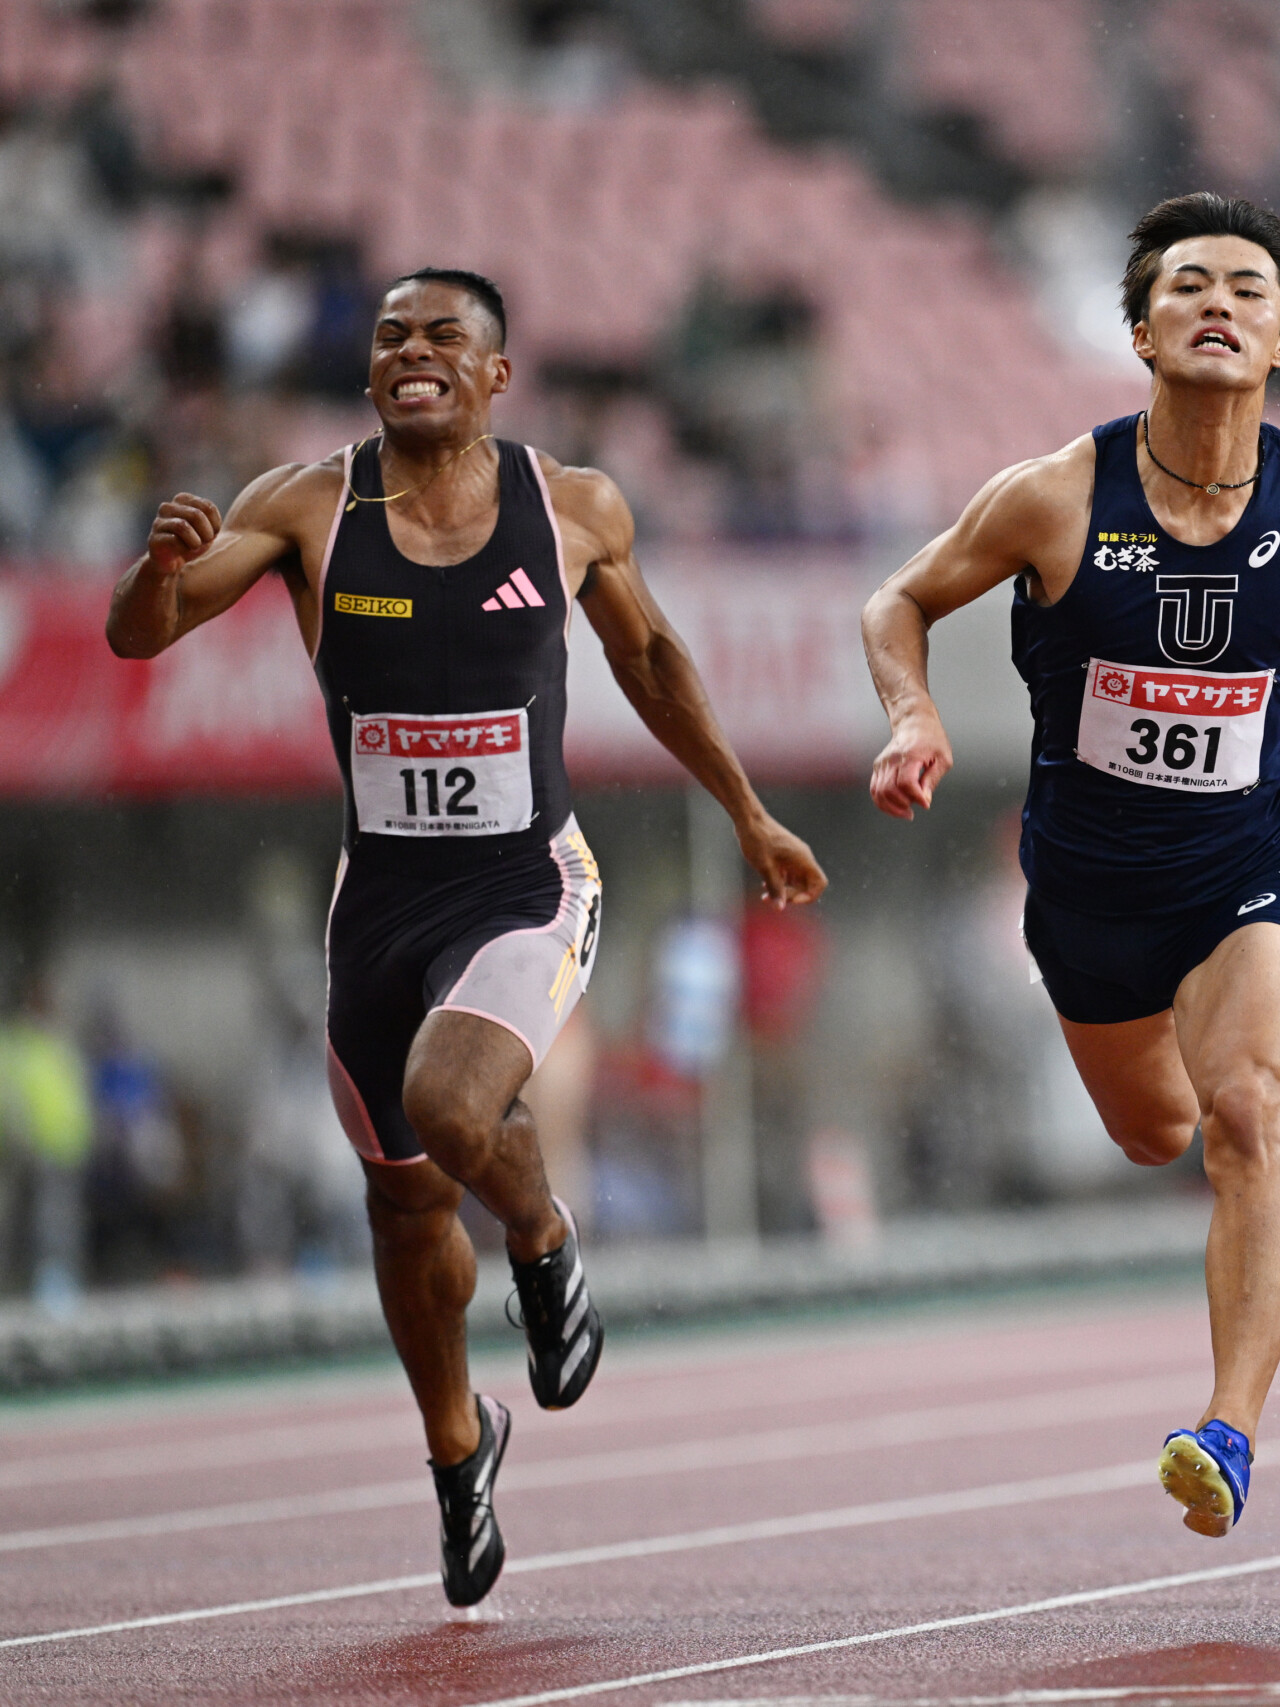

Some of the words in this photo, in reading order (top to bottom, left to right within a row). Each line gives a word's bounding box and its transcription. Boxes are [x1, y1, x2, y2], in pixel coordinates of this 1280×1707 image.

[1098, 532, 1158, 544] 健康ミネラル
[1093, 544, 1160, 573] むぎ茶
[338, 593, 408, 616] SEIKO
[1142, 681, 1259, 708] ヤマザキ
[395, 724, 512, 751] ヤマザキ
[1125, 718, 1222, 774] 361
[1108, 761, 1143, 779] 第108回
[400, 767, 478, 816] 112
